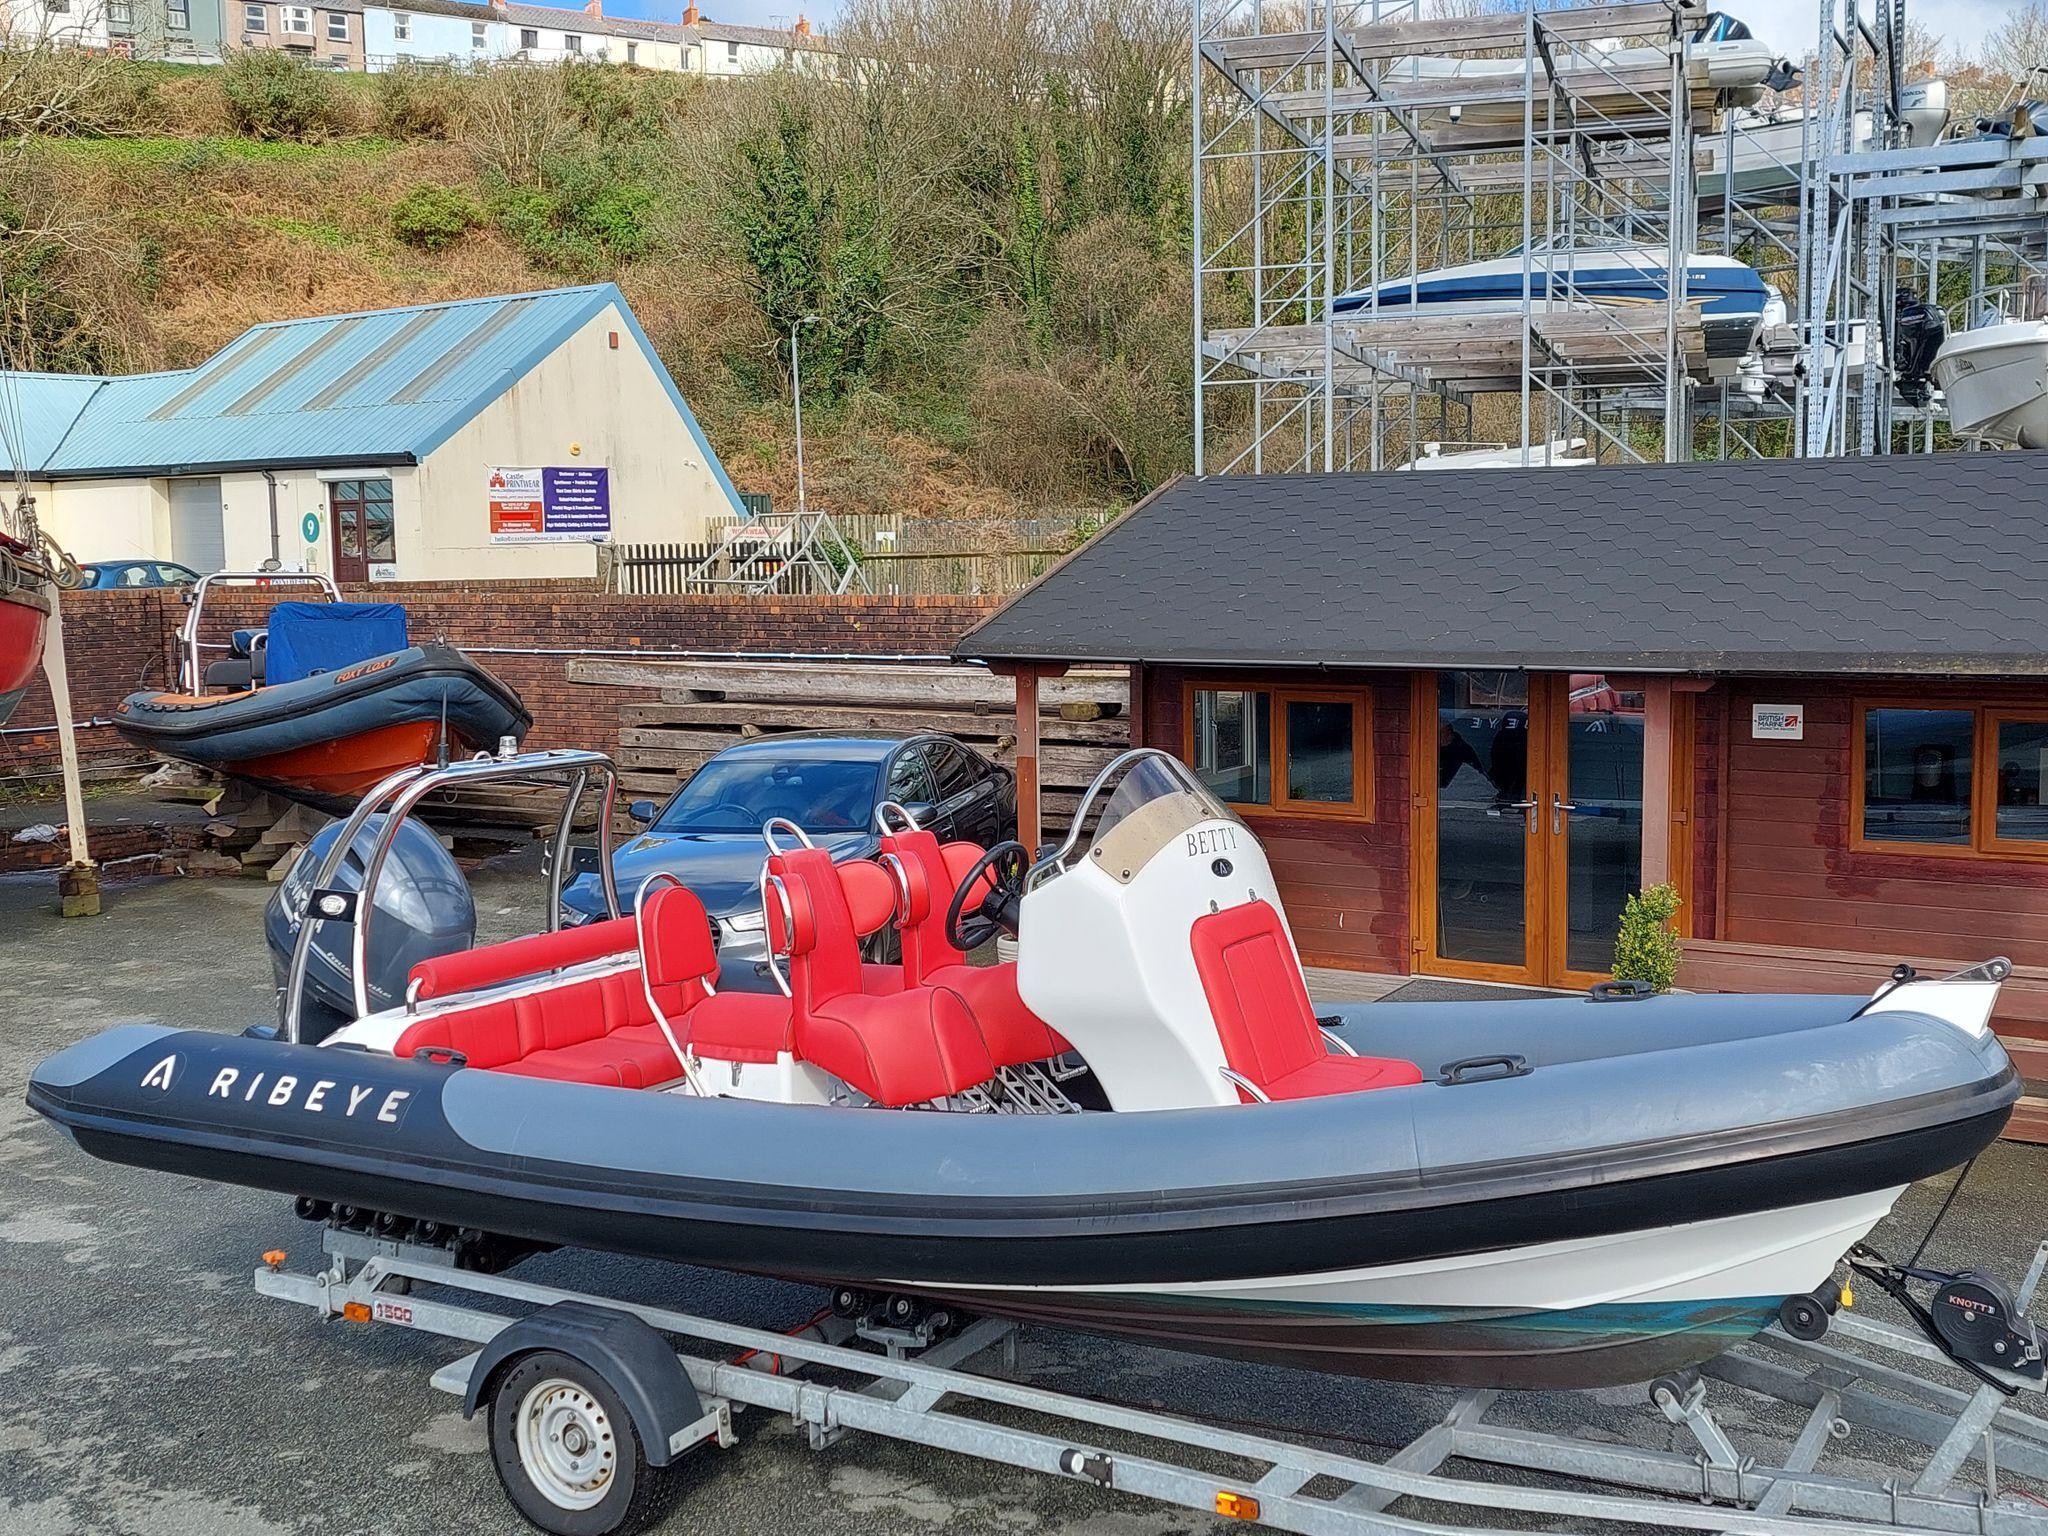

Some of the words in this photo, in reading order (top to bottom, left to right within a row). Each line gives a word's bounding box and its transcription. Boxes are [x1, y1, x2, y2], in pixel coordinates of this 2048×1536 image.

[506, 480, 540, 488] PRINTWEAR
[307, 520, 314, 535] 9
[336, 667, 363, 683] FOXY
[366, 658, 395, 674] LOXY
[1186, 826, 1237, 857] BETTY
[208, 1067, 410, 1123] RIBEYE
[376, 1303, 413, 1323] 1500
[1948, 1295, 1988, 1312] KNOTT
